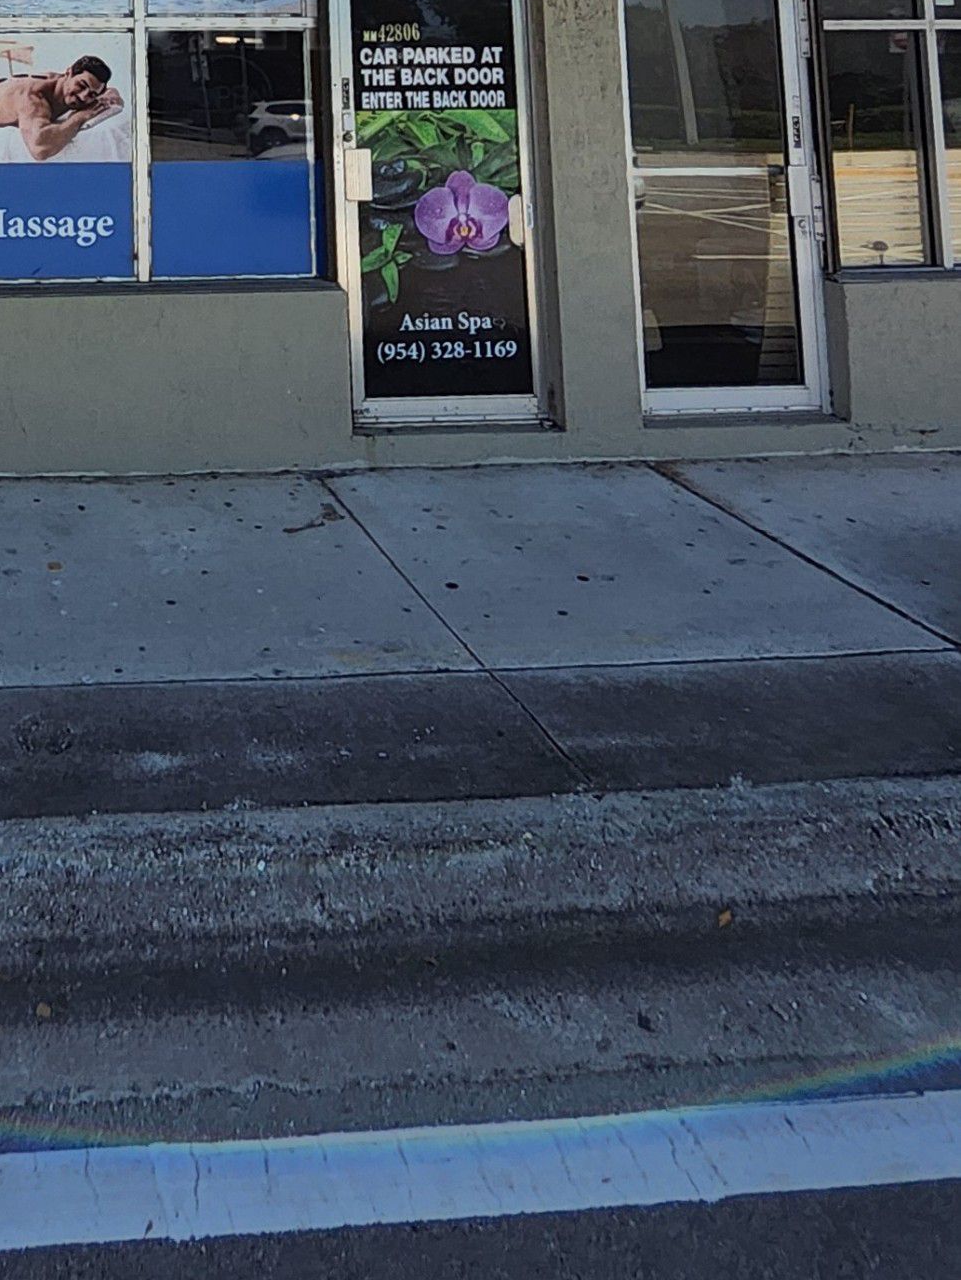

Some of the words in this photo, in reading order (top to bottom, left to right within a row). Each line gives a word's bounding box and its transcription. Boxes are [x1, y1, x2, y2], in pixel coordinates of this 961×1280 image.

[360, 47, 398, 65] CAR
[402, 46, 475, 64] PARKED
[481, 46, 503, 63] AT
[361, 69, 396, 86] THE
[401, 68, 449, 85] BACK
[454, 68, 504, 85] DOOR
[361, 91, 403, 109] ENTER
[406, 91, 430, 108] THE
[433, 90, 468, 108] BACK
[470, 90, 505, 107] DOOR
[399, 312, 453, 332] Asian
[458, 311, 492, 335] Spa
[377, 341, 425, 364] (954)
[431, 340, 517, 359] 328-1169
